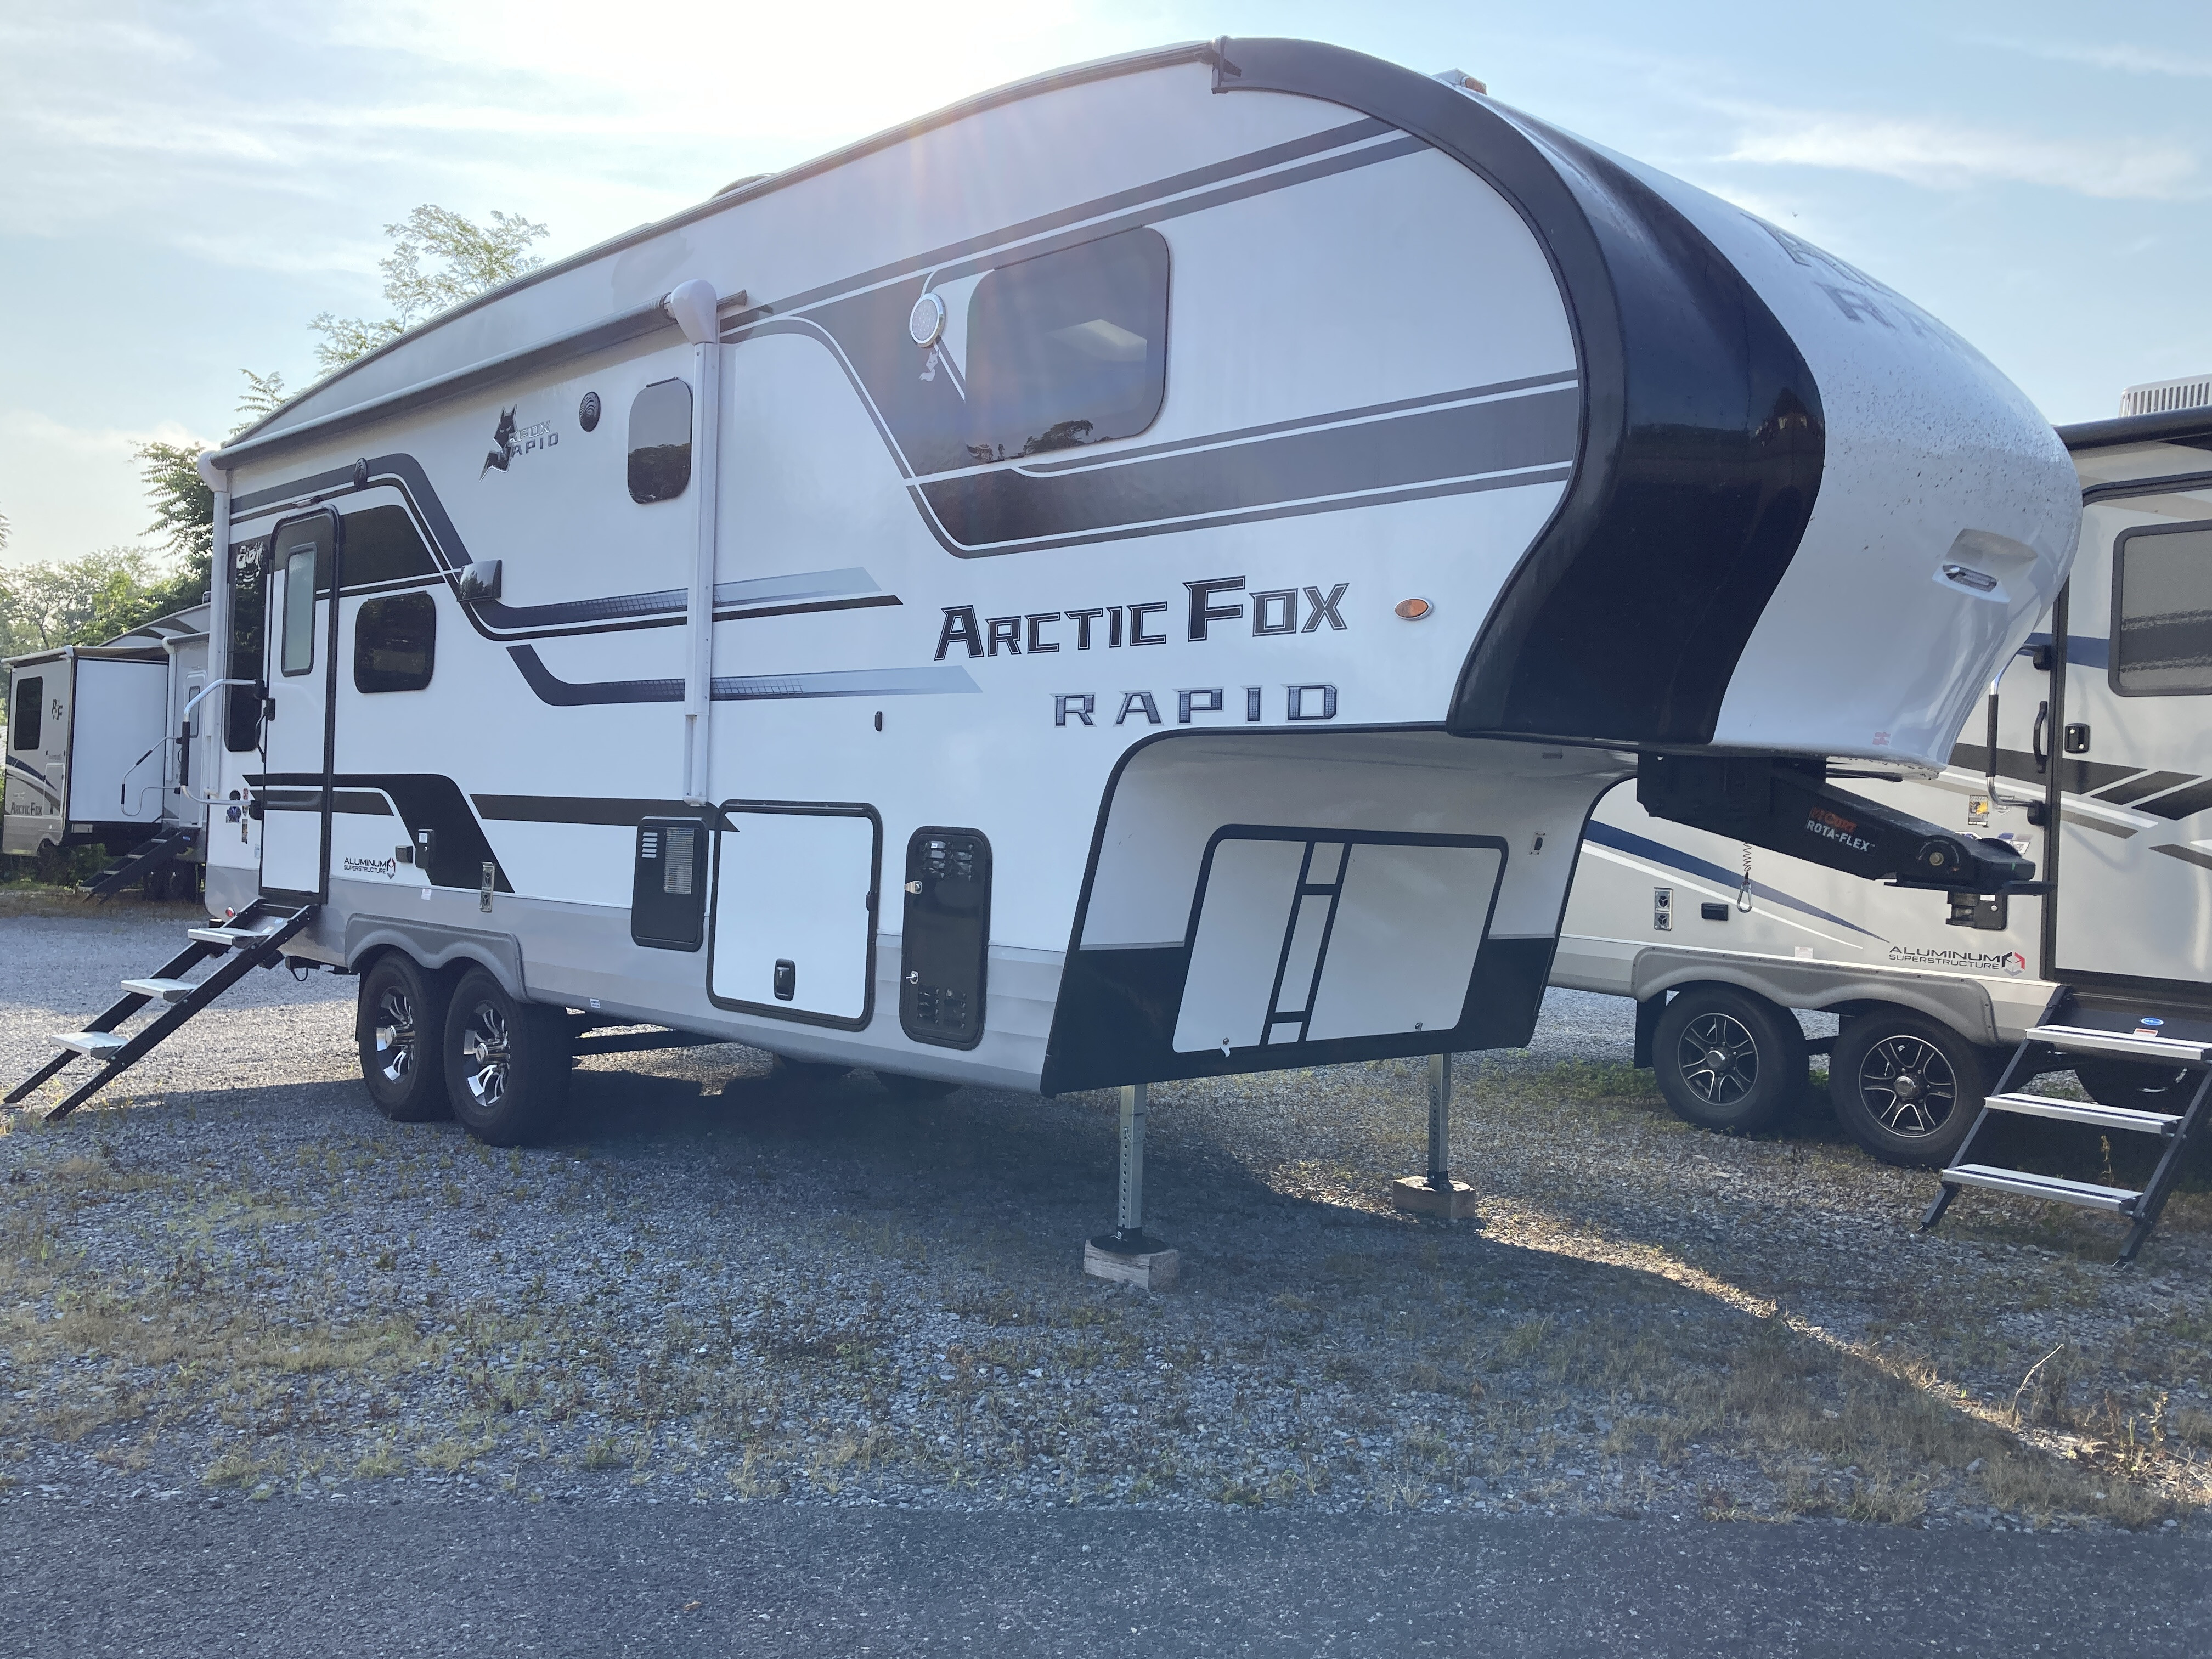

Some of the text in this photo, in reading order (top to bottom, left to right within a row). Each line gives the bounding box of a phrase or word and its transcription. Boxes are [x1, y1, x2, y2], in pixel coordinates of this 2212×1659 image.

[508, 420, 550, 443] AFOX
[934, 575, 1350, 661] ARCTIC FOX
[1051, 682, 1339, 727] RAPID
[343, 865, 386, 874] SUPERSTRUCTURE
[344, 857, 386, 867] ALUMINUM
[1889, 946, 2000, 963] ALUMINUM
[1889, 954, 1999, 969] SUPERSTRUCTURE
